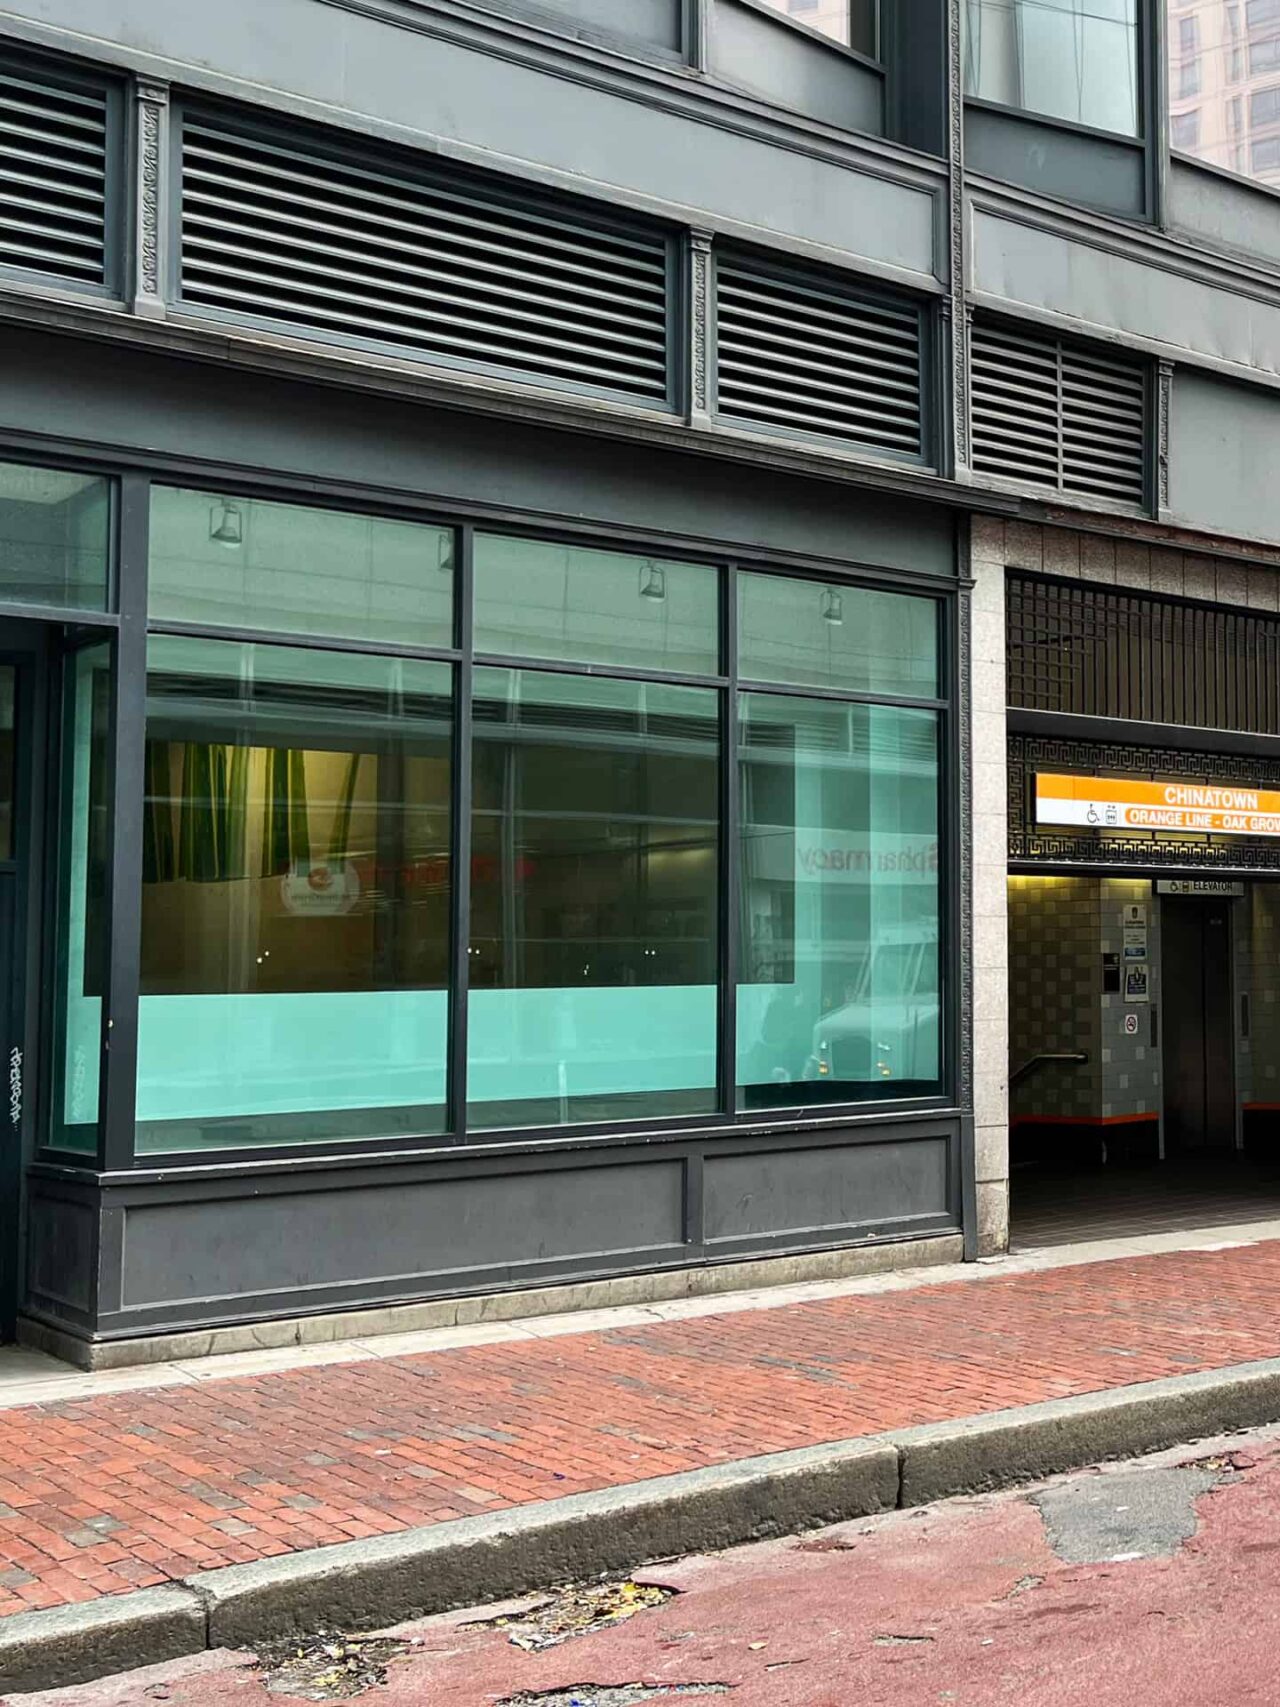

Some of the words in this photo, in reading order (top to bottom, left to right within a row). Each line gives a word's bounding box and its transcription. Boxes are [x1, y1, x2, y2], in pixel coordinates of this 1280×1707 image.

[1164, 787, 1258, 809] CHINATOWN
[1130, 810, 1184, 826] ORANGE
[1186, 813, 1213, 828] LINE
[1222, 816, 1247, 829] OAK
[1193, 881, 1233, 892] ELEVATOR
